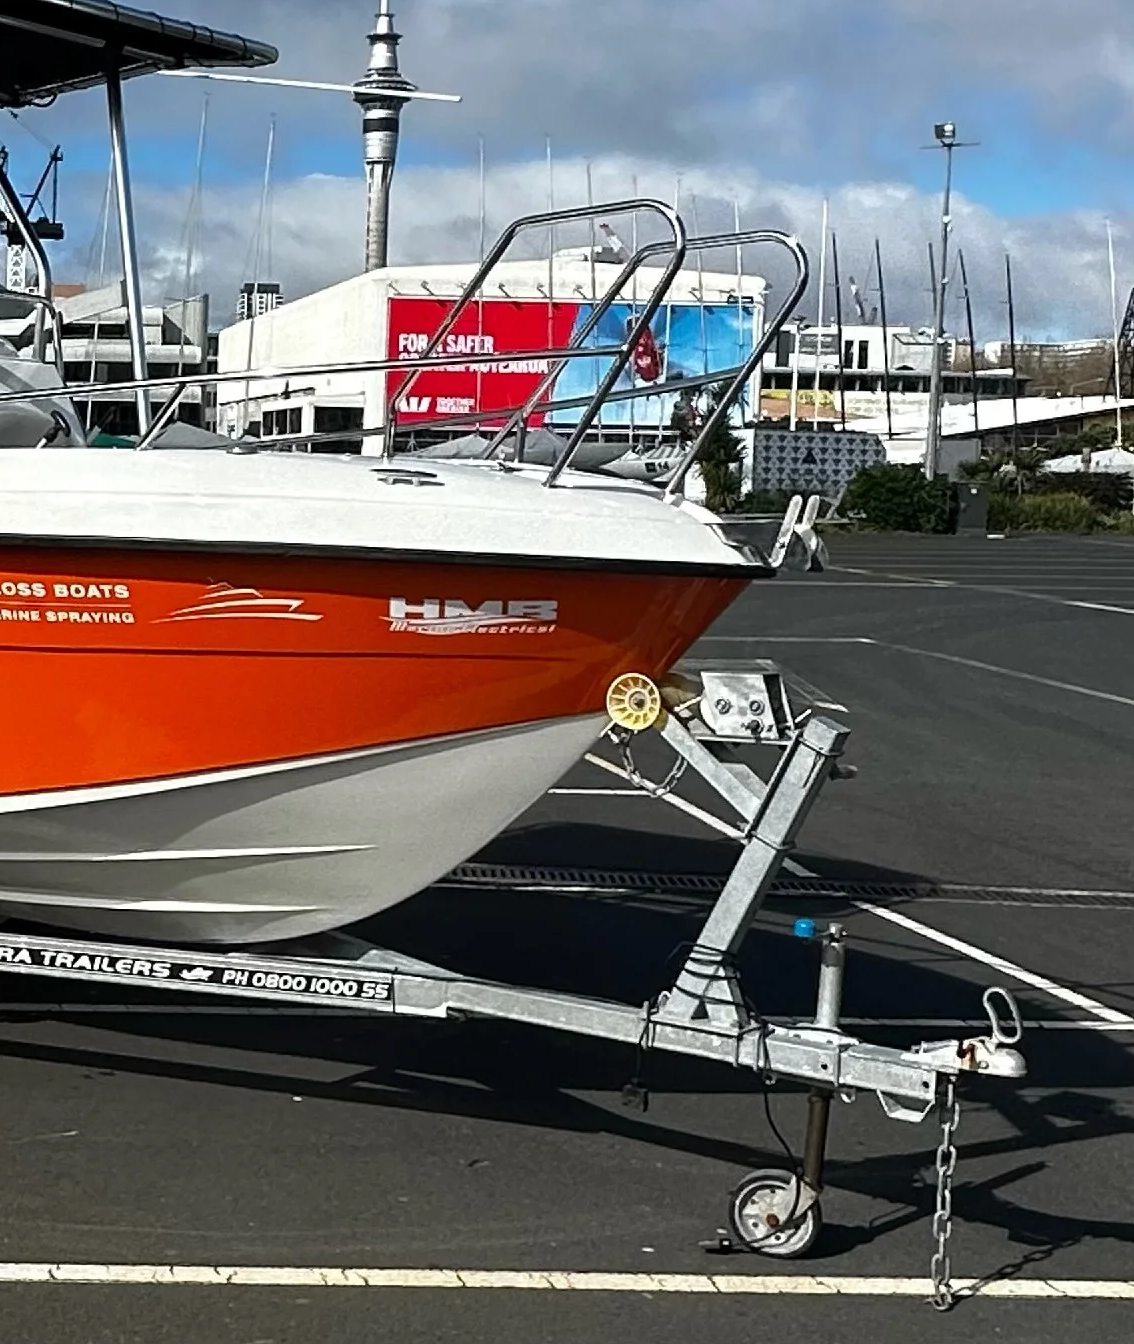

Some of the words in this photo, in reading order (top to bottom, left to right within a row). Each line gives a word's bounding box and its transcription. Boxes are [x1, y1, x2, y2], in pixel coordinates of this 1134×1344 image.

[399, 333, 428, 353] FOR
[446, 335, 494, 354] SAFER
[53, 582, 130, 599] BOATS
[45, 610, 135, 624] SPRAYING
[40, 951, 172, 979] TRAILERS
[222, 969, 249, 985] PH
[252, 972, 306, 991] 0800
[309, 978, 358, 996] 1000
